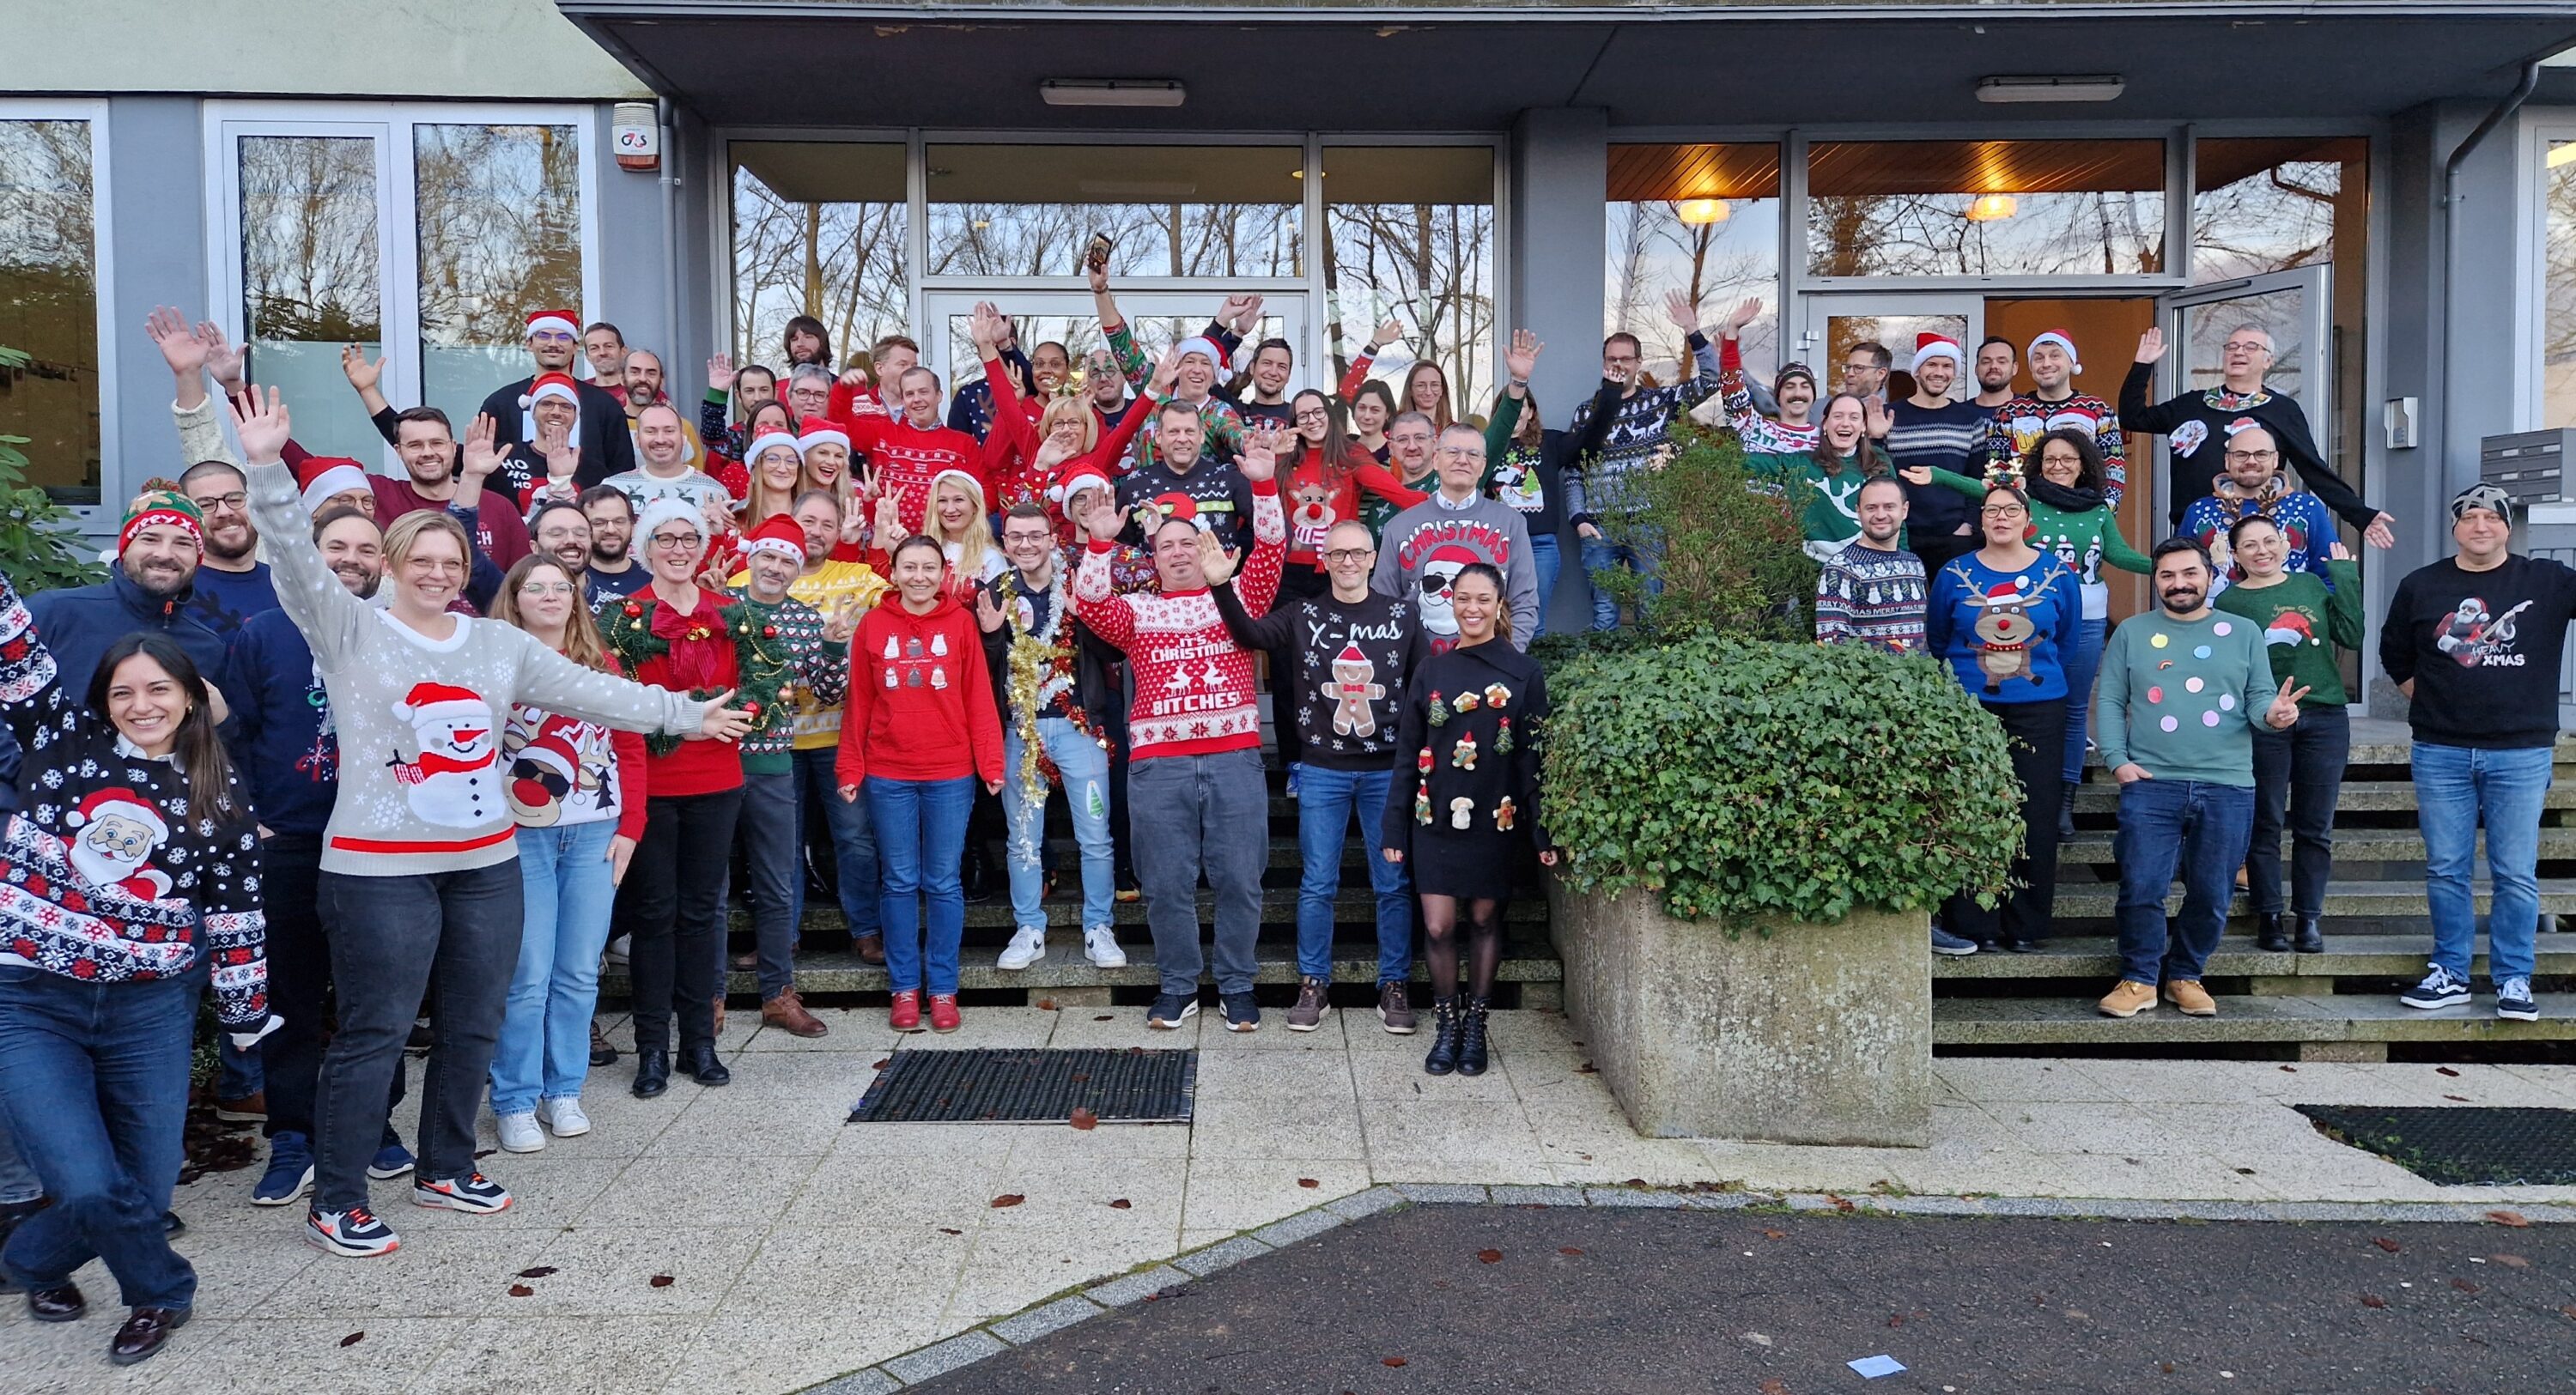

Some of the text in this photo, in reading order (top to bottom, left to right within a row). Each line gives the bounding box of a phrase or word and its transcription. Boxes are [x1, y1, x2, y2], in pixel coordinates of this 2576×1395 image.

[501, 458, 529, 470] HO
[507, 470, 532, 480] HO
[513, 481, 532, 489] HO
[1399, 519, 1510, 571] CHRISTMAS
[2471, 642, 2516, 659] HEAVY
[2482, 653, 2525, 667] XMAS
[1152, 691, 1240, 716] BITCHES!
